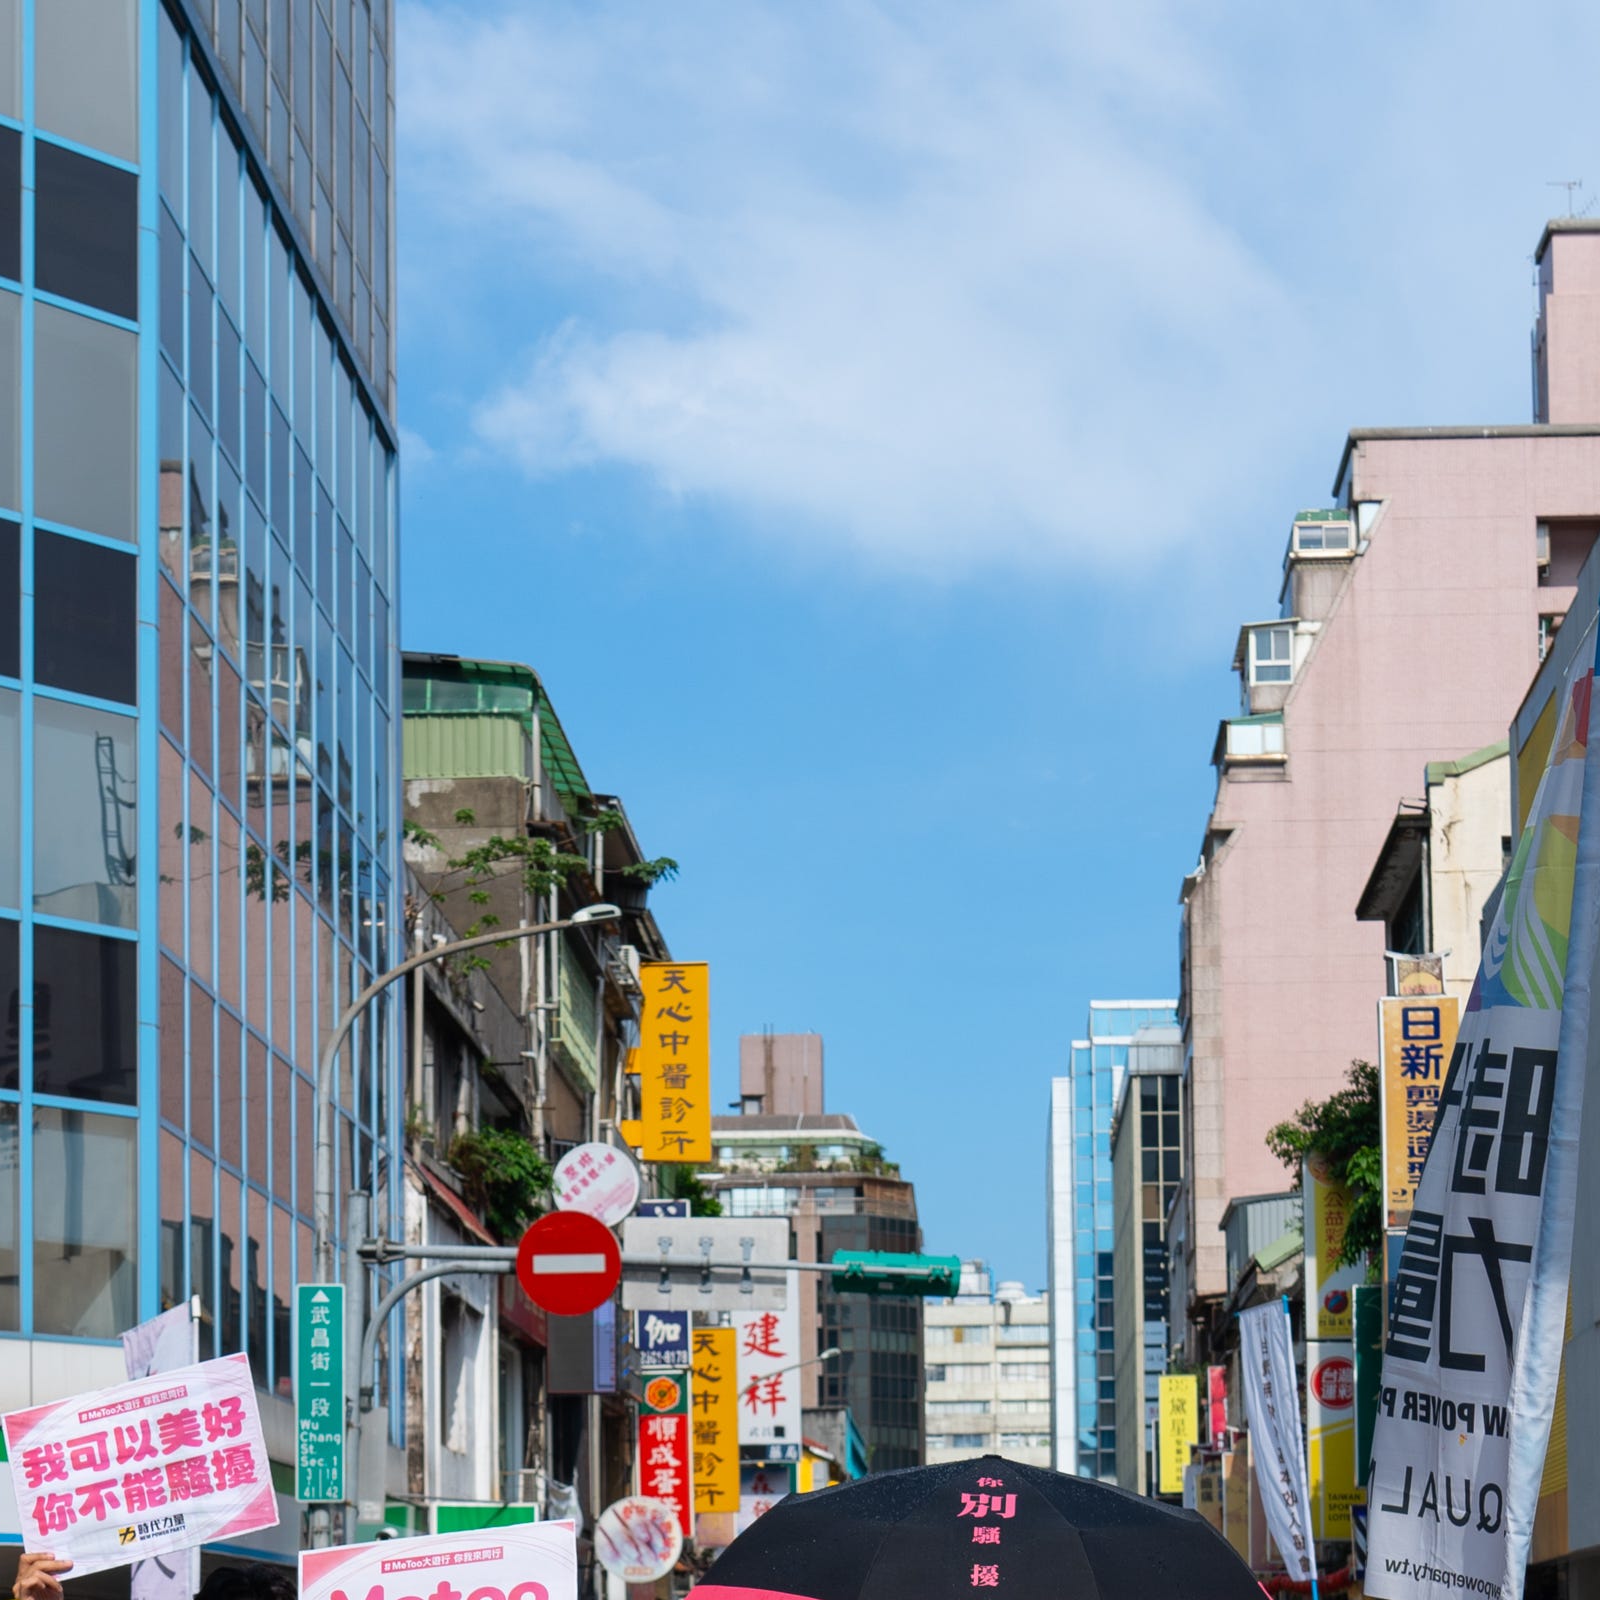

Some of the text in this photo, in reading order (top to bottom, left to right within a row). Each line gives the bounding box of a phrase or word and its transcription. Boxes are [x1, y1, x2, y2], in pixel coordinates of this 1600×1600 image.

[1400, 1006, 1444, 1081] 日新
[655, 968, 695, 1155] 天心中醫診所
[309, 1305, 331, 1418] 武昌街一段
[741, 1312, 788, 1417] 建祥
[300, 1419, 319, 1431] Wu
[691, 1333, 724, 1506] 天心中醫診所
[22, 1396, 247, 1489] 我可以美好
[300, 1432, 342, 1445] Chang
[300, 1443, 316, 1455] St.
[300, 1456, 338, 1467] Sec. 1
[306, 1468, 313, 1481] 3
[32, 1442, 258, 1537] 你不能騷擾
[303, 1486, 338, 1499] 41 42
[1328, 1493, 1361, 1501] TAIWAN
[138, 1513, 185, 1535] 時代力量
[383, 1548, 502, 1572] #MeToo大遊行 你我來同行
